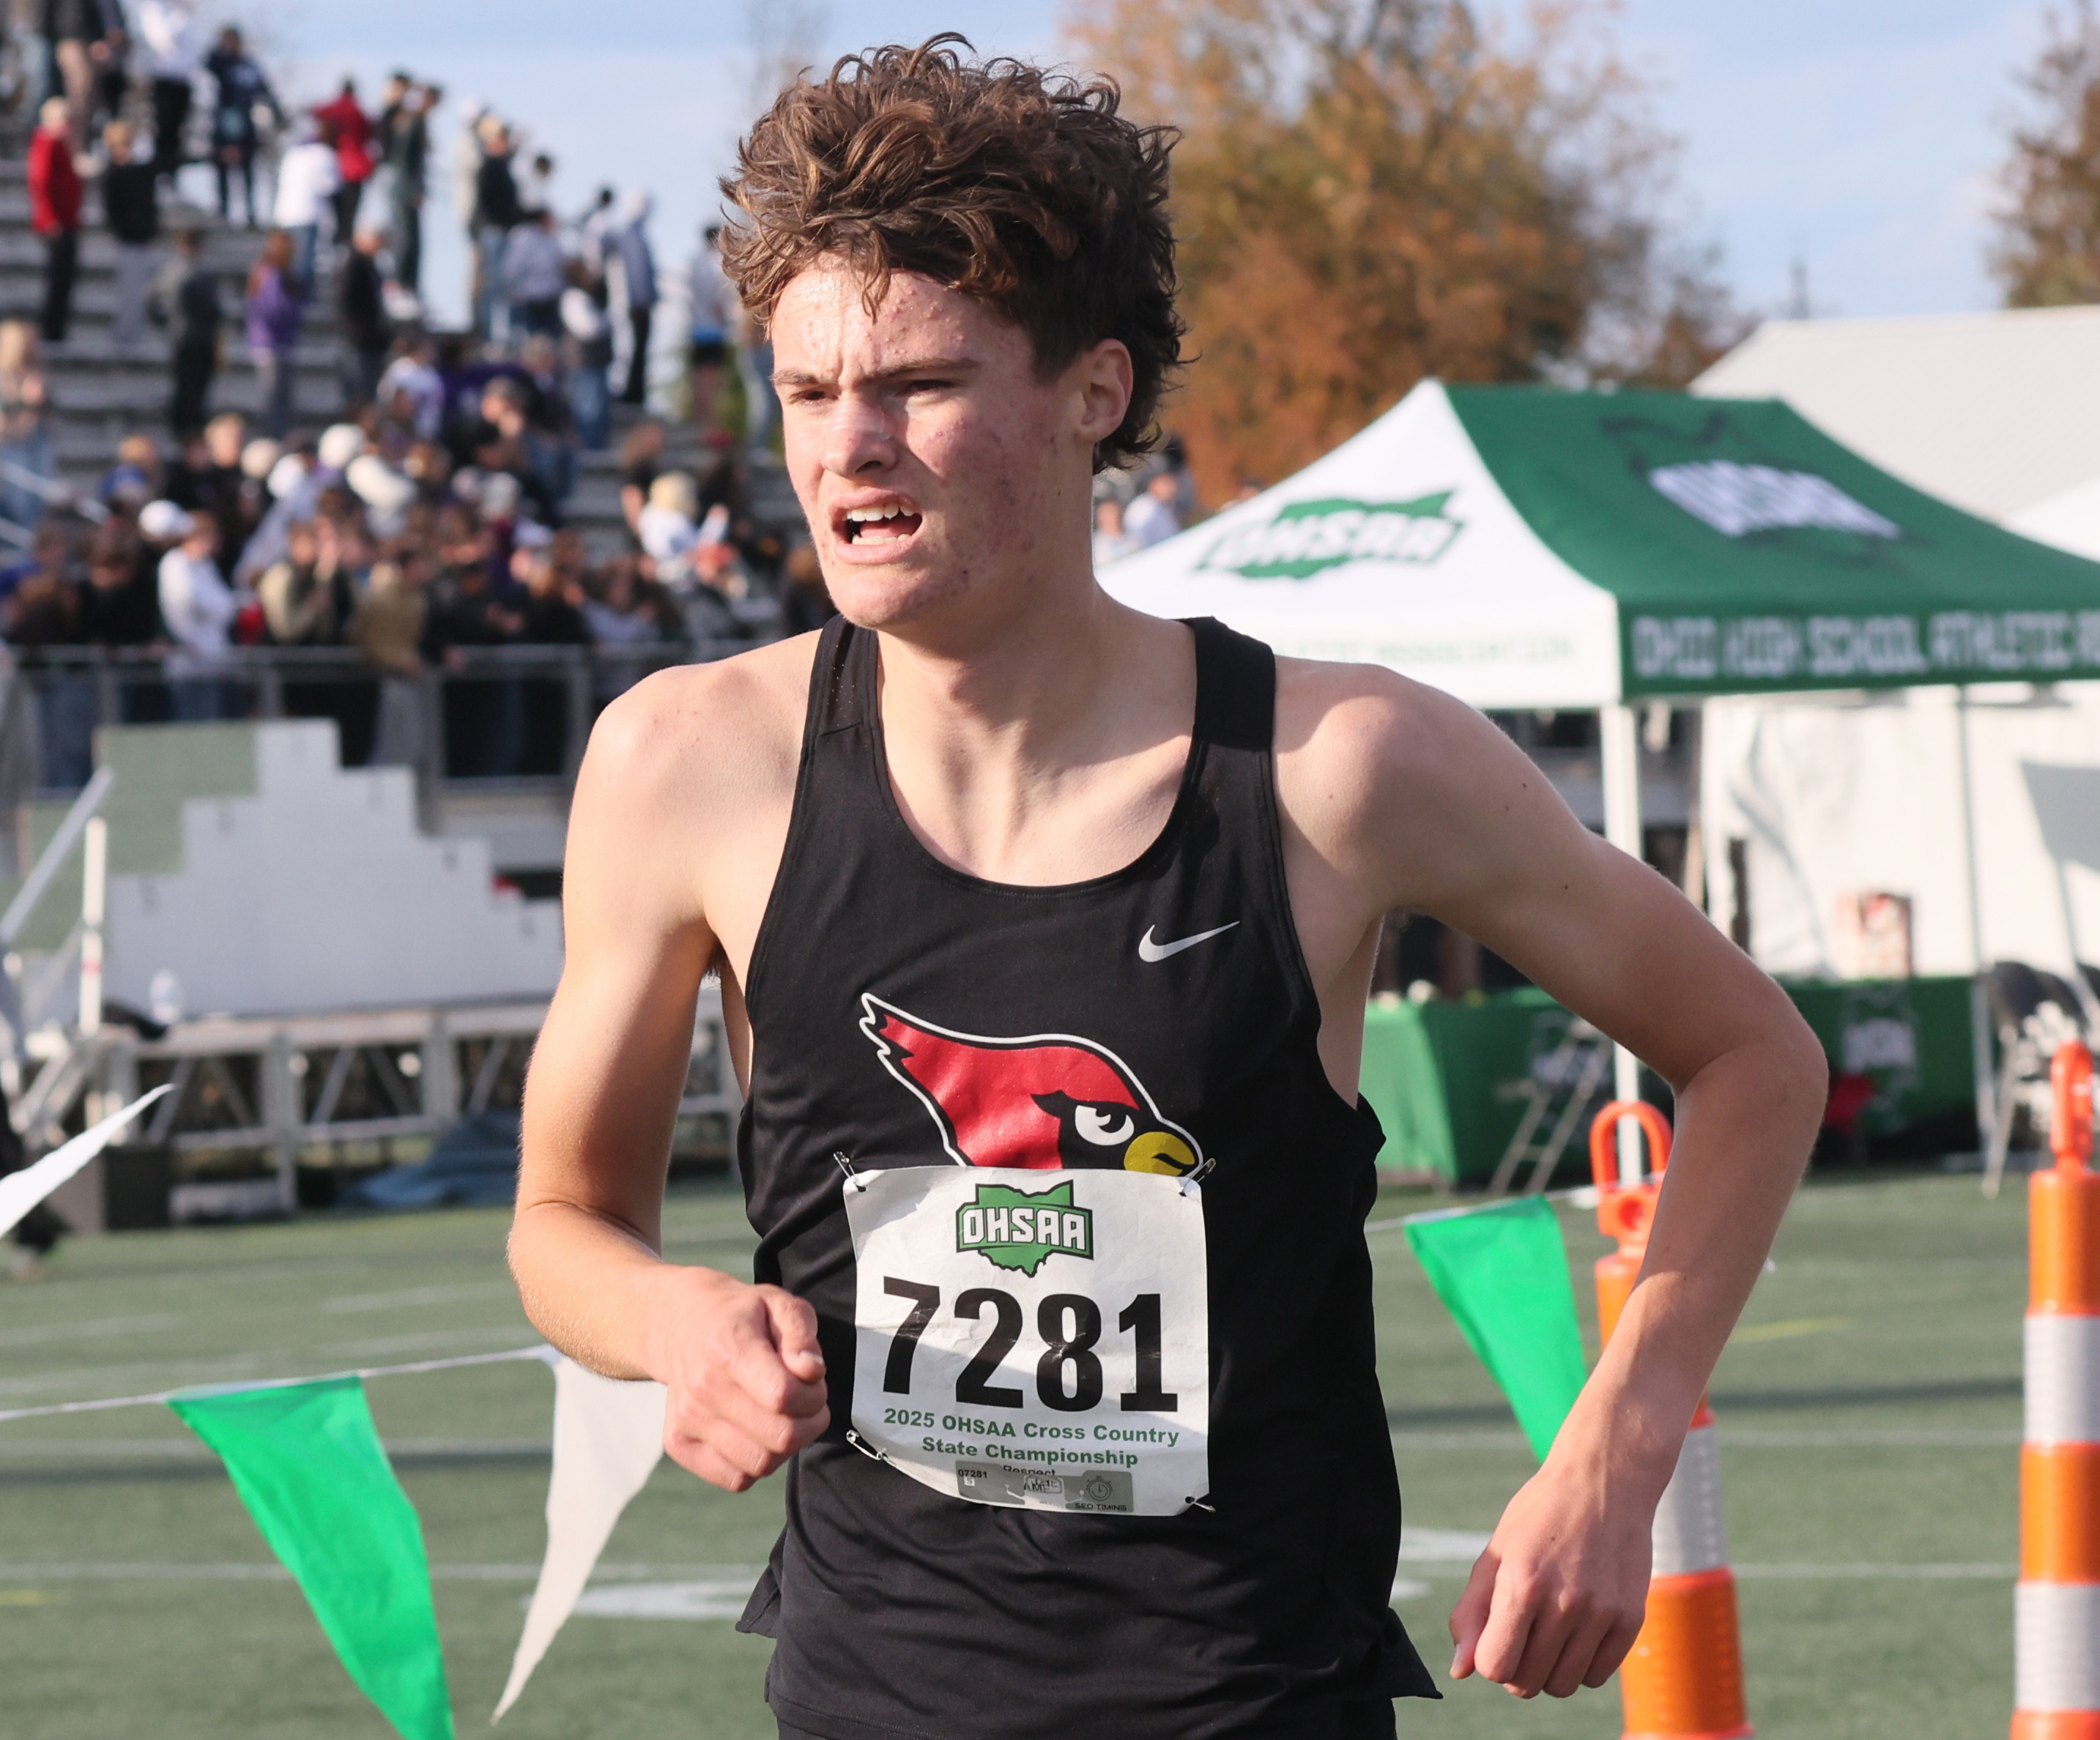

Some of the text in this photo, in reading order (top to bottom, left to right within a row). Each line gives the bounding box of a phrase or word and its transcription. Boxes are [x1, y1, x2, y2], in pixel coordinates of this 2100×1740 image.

[962, 1207, 1086, 1251] OHSAA
[883, 1276, 1178, 1412] 7281
[883, 1408, 1180, 1447] 2025 OHSAA Cross Country
[923, 1436, 1138, 1468] State Championship
[958, 1469, 988, 1479] 07281
[1097, 1503, 1127, 1512] TIMING
